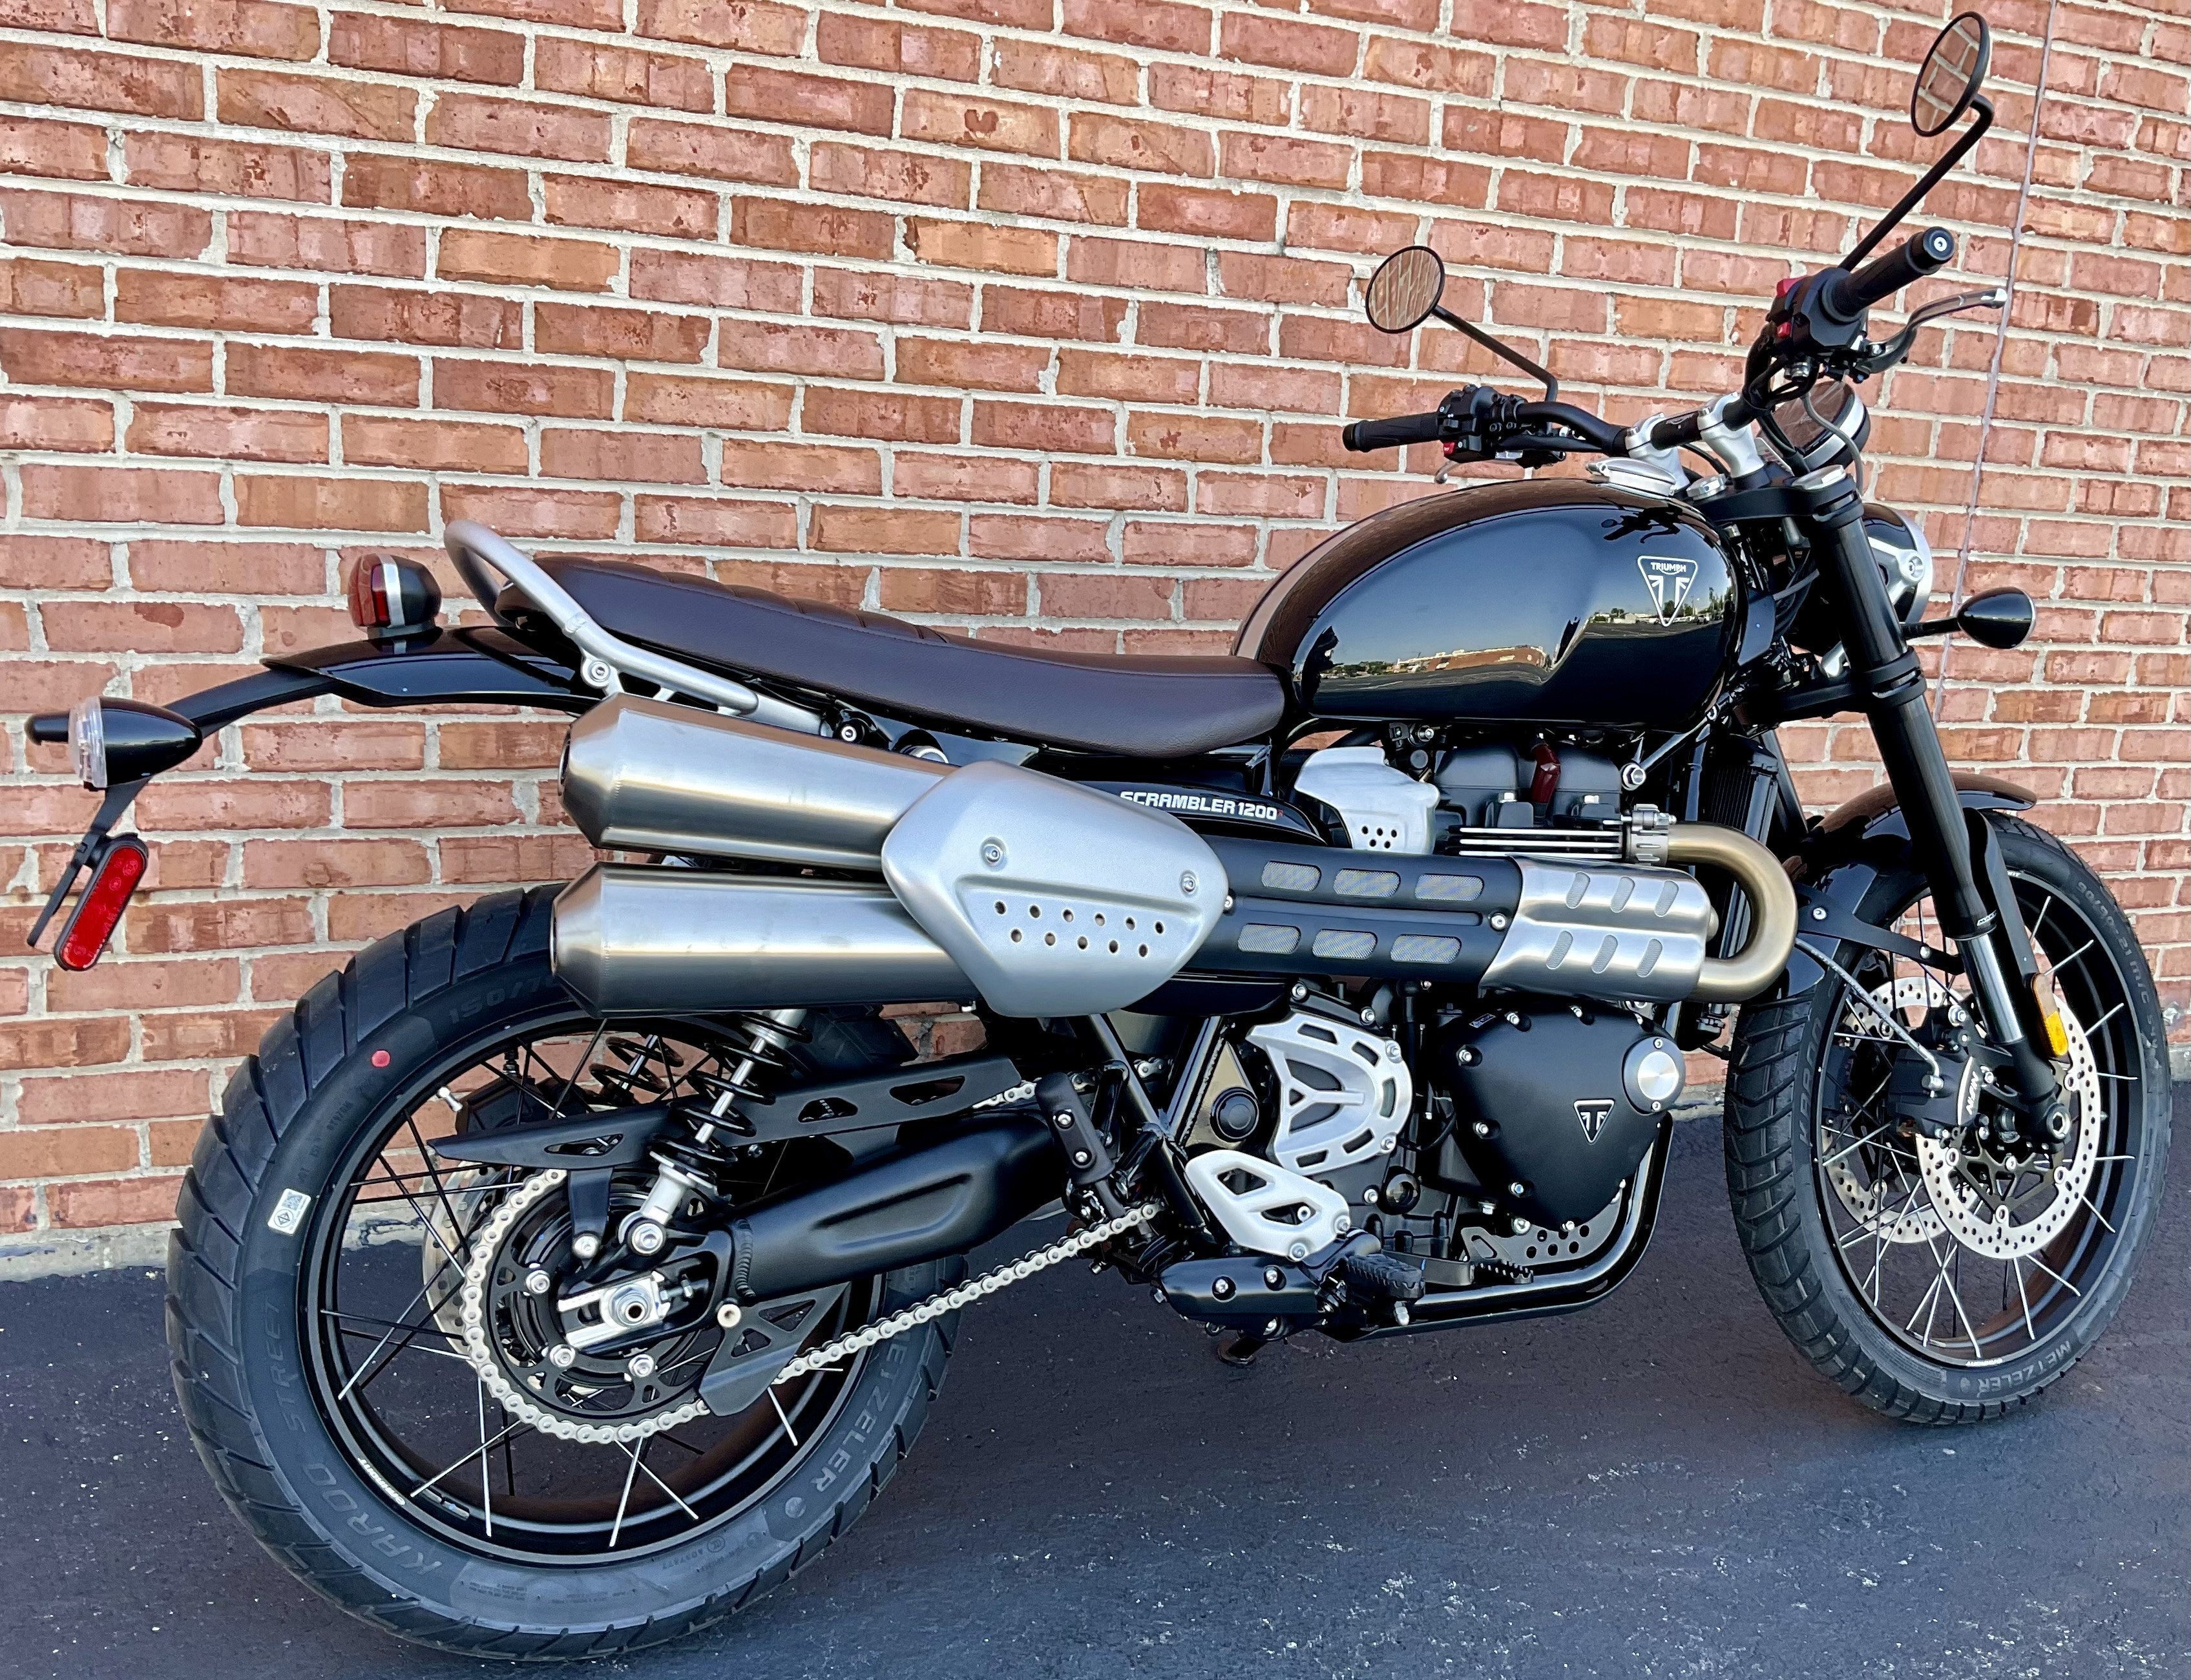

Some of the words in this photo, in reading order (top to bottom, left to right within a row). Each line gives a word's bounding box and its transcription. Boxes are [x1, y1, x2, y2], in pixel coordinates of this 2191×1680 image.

[1650, 562, 1686, 574] TRIUMPH
[1120, 791, 1235, 814] SCRAMBLER
[1237, 802, 1277, 821] 1200
[1966, 1071, 1979, 1115] NISSIN
[262, 1302, 308, 1433] STREET
[1976, 1340, 2072, 1398] METZELER
[810, 1331, 910, 1493] ETZELER
